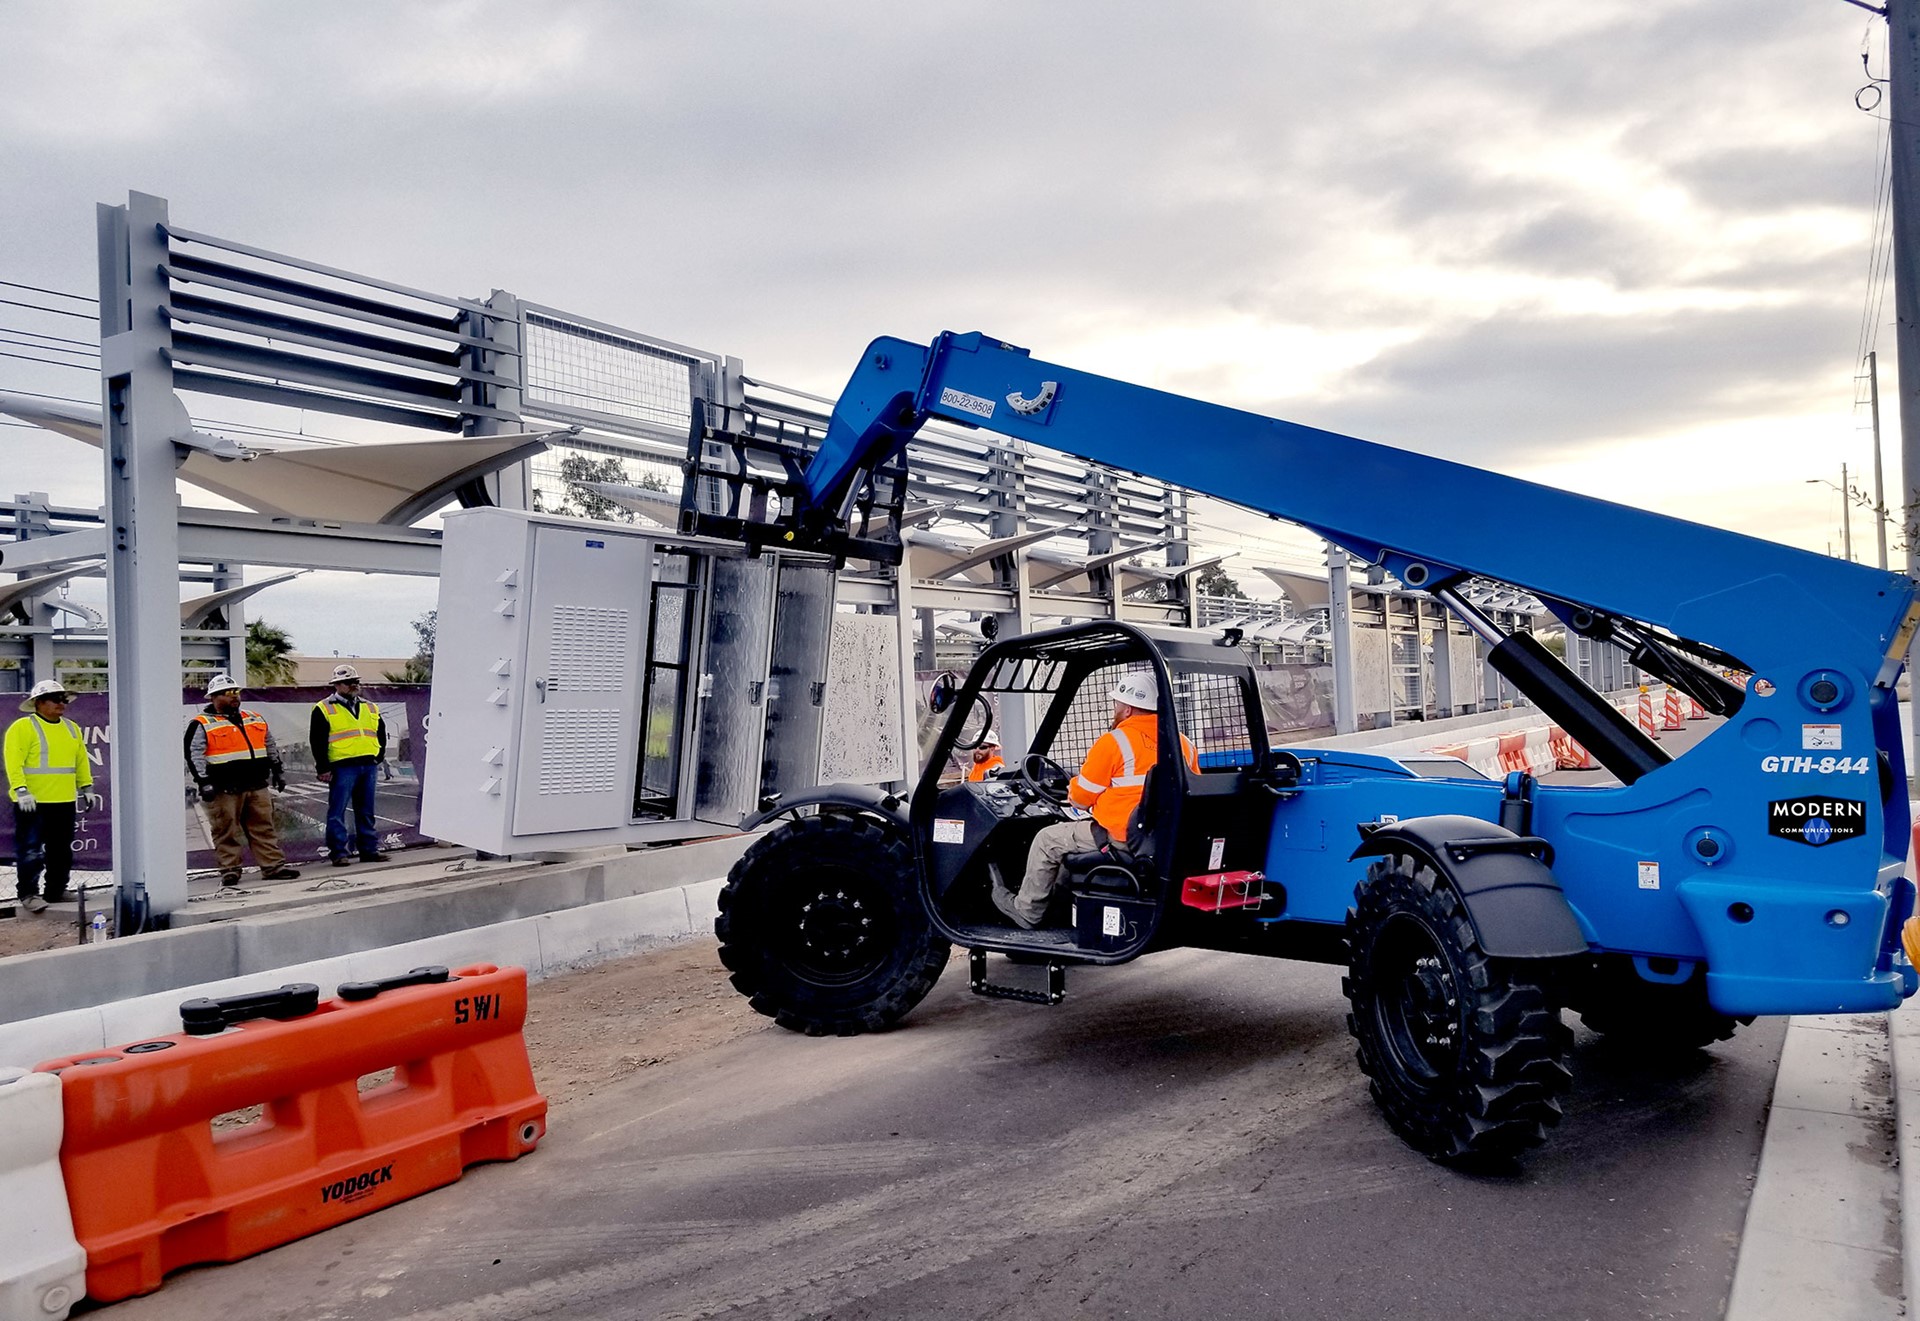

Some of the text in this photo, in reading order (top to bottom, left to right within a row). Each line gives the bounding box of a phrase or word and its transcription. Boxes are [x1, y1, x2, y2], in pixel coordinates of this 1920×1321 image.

[942, 391, 993, 414] 800-22-9508
[1761, 756, 1870, 774] GTH-844
[1773, 802, 1862, 817] MODERN
[322, 1164, 393, 1204] YODOCK
